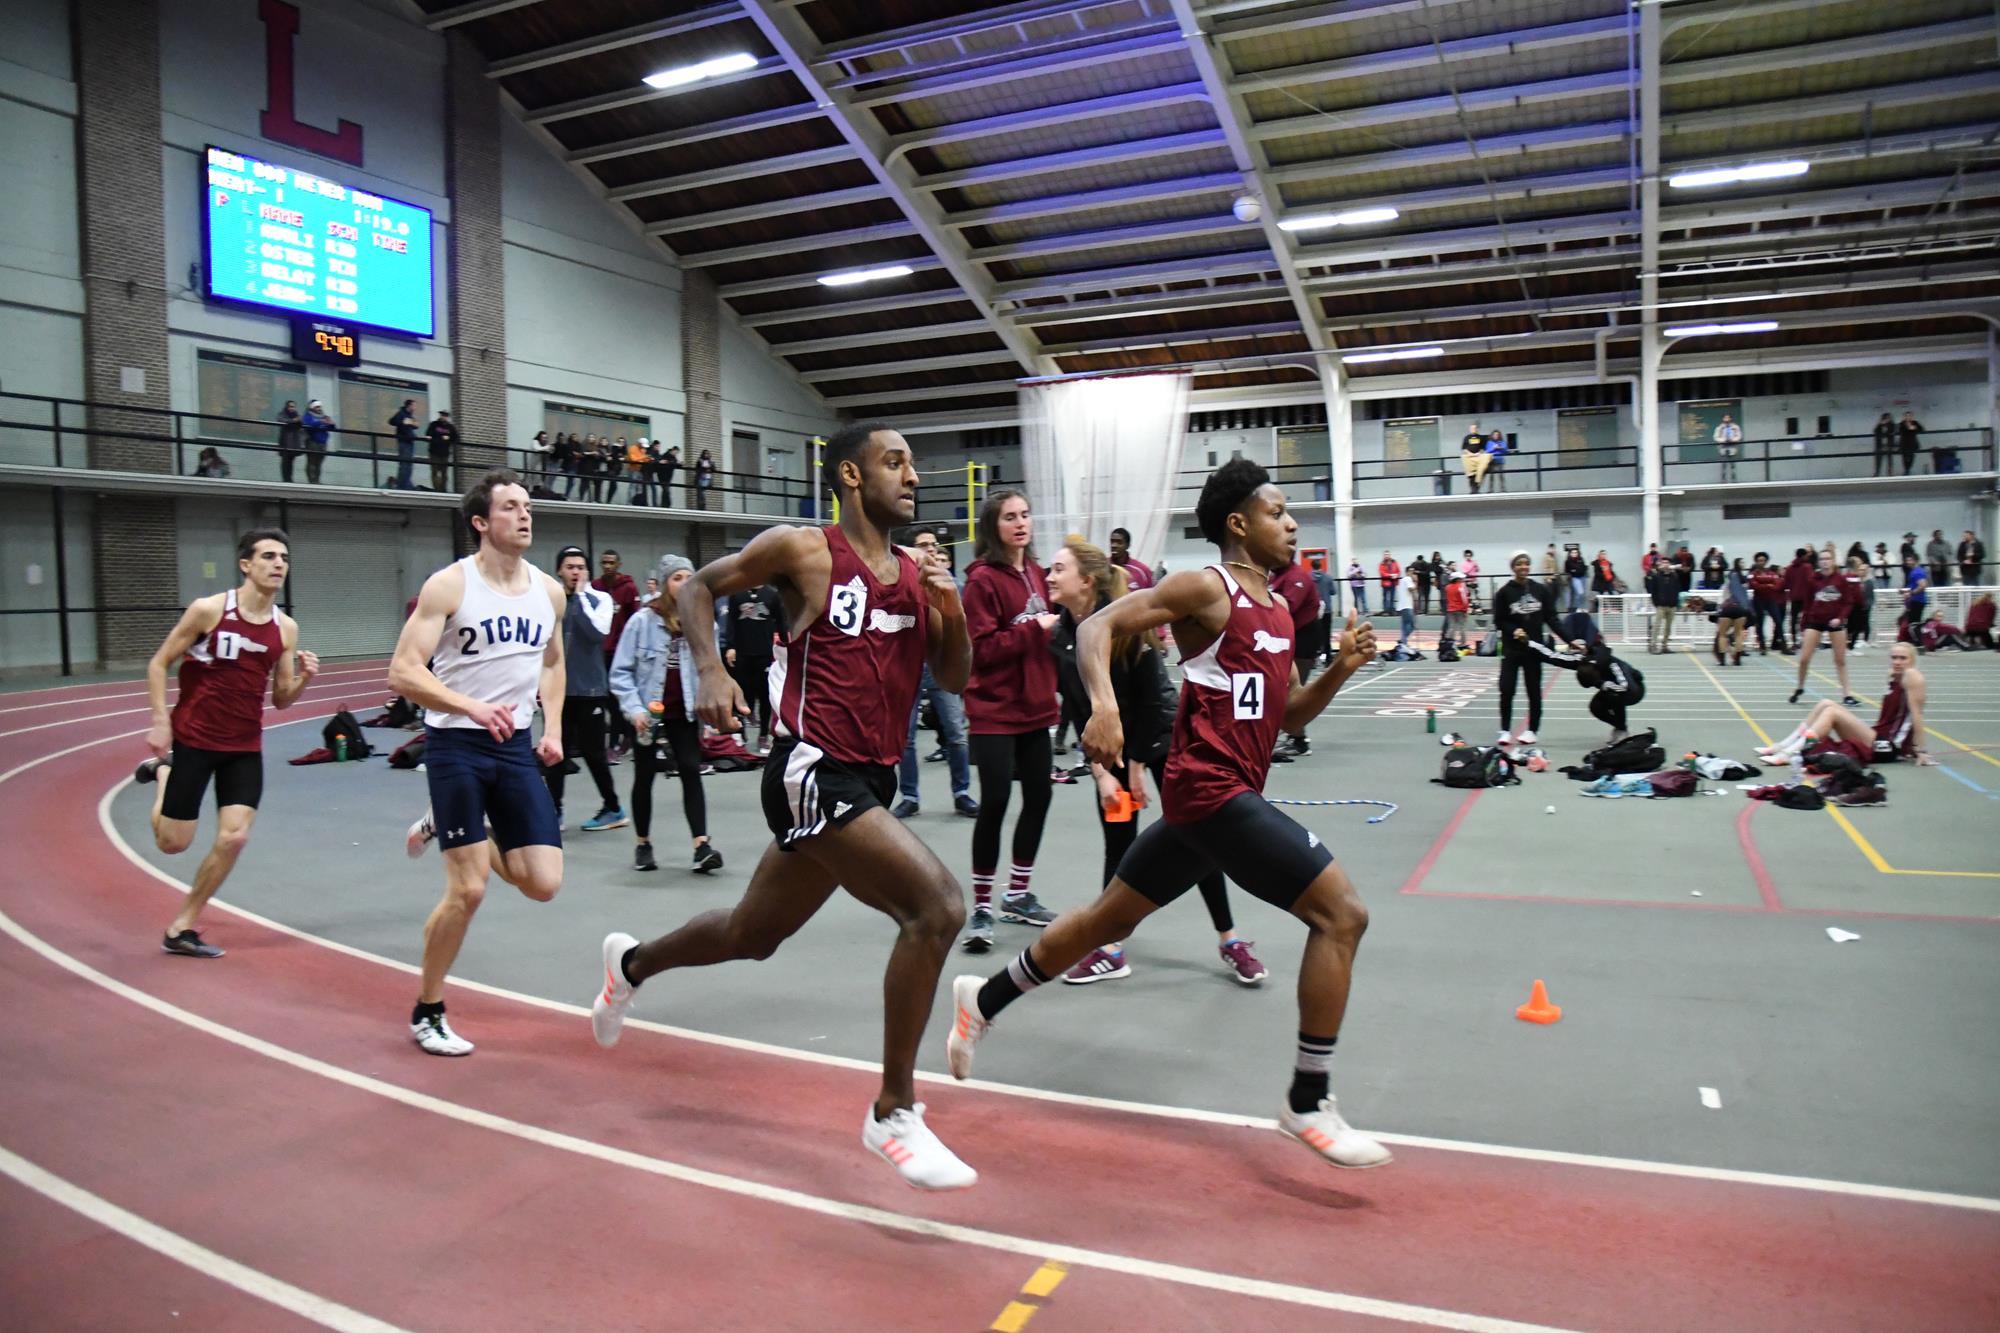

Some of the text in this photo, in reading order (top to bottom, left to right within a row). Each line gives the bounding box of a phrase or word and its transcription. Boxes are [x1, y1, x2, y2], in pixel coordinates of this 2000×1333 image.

[259, 0, 364, 168] L
[294, 173, 346, 200] METER
[833, 591, 857, 629] 3
[459, 616, 542, 655] 2 TCNJ
[1239, 677, 1259, 715] 4
